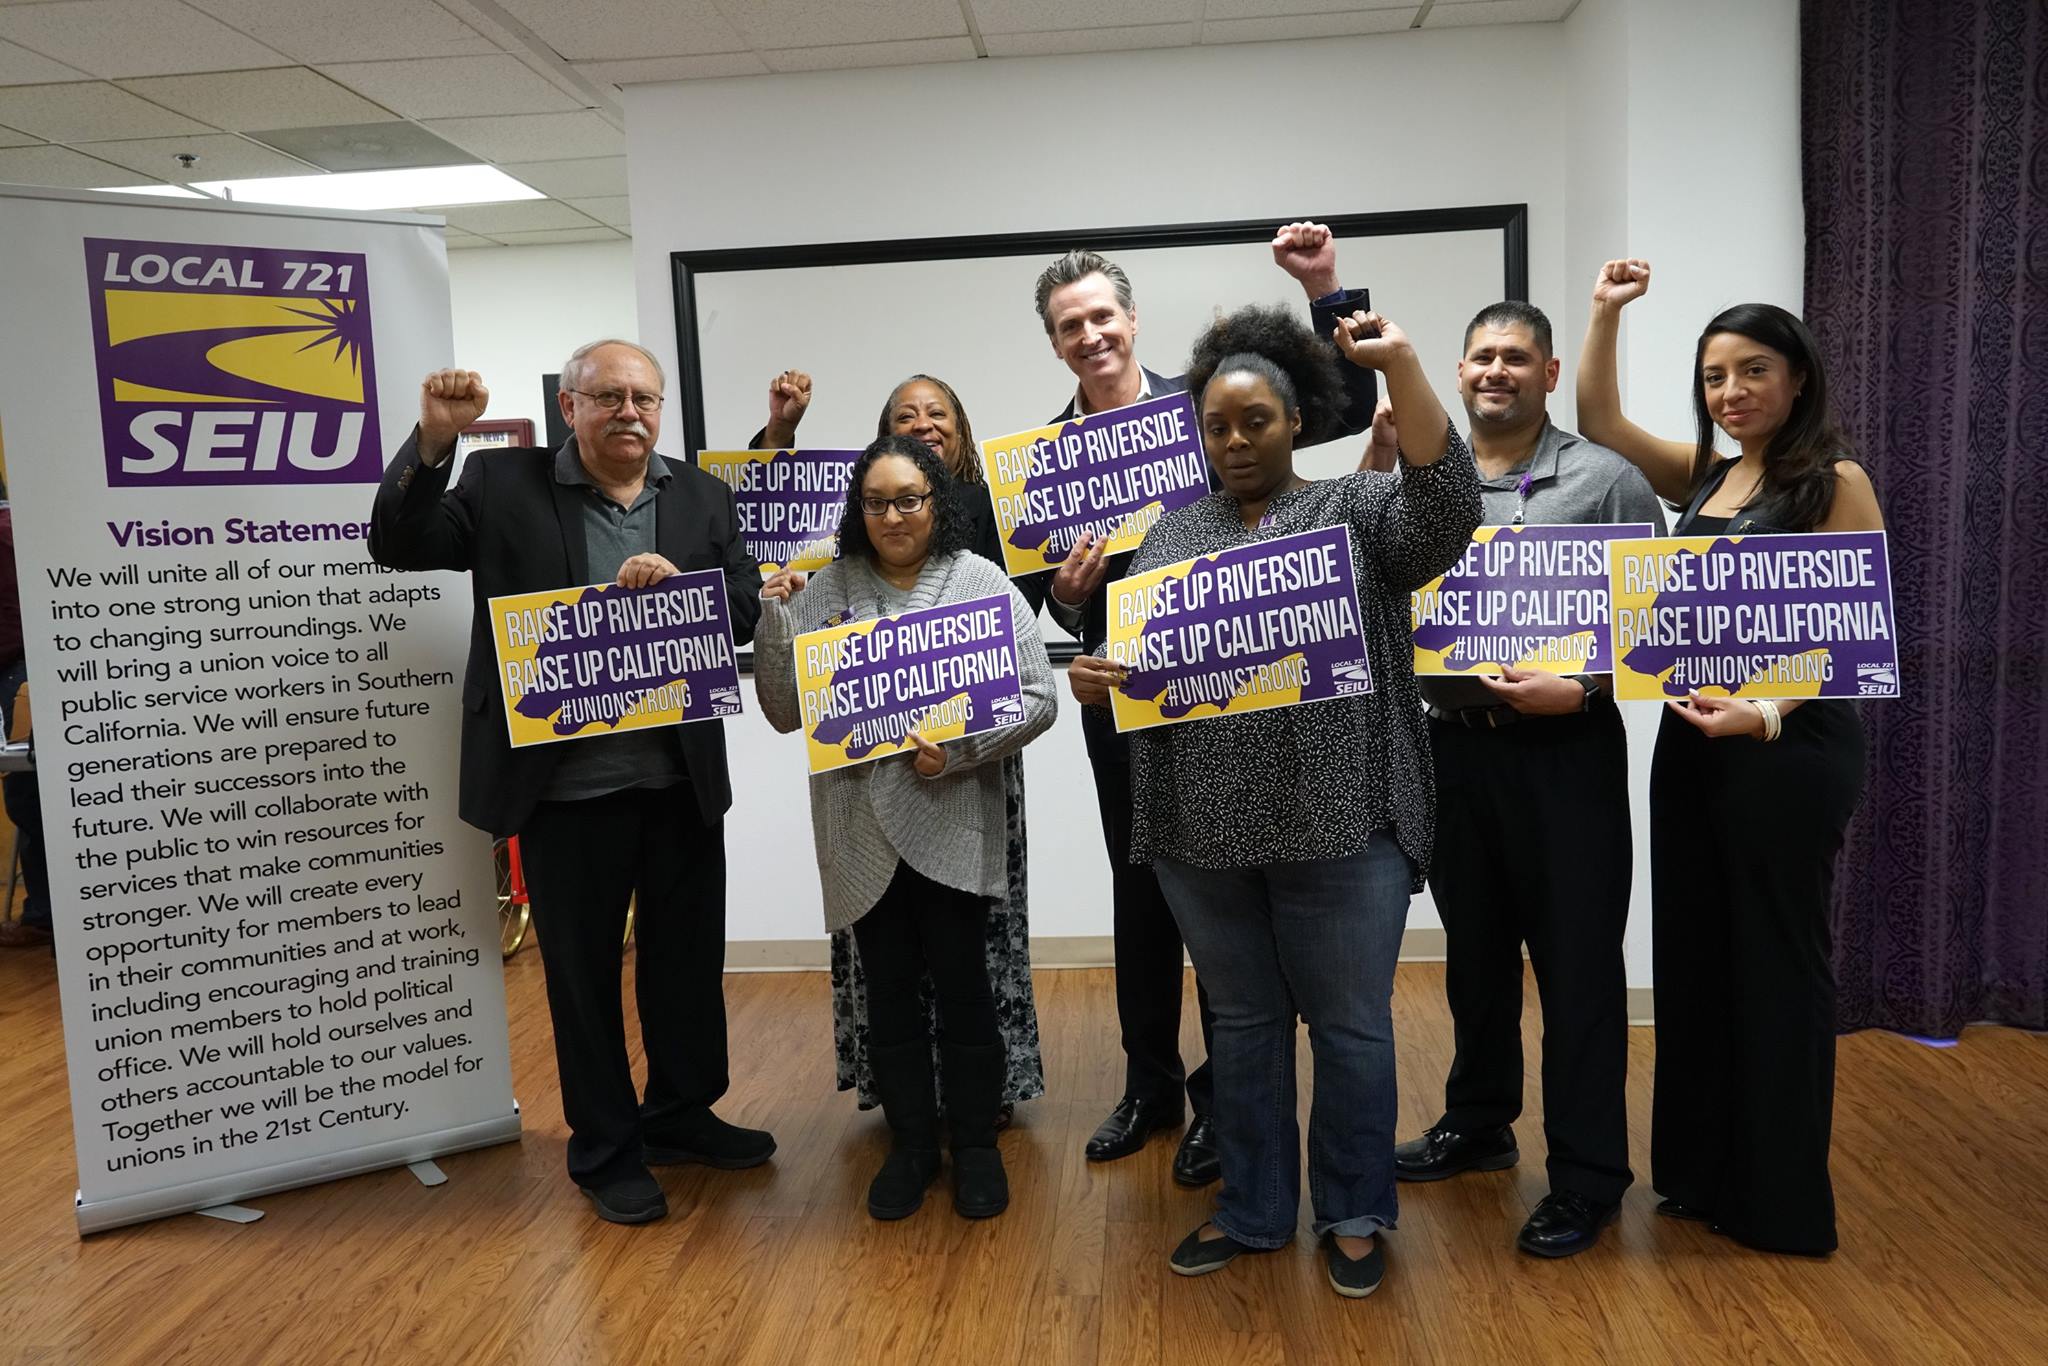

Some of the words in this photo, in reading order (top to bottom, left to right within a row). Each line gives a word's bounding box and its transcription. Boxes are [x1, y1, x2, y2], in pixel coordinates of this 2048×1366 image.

[104, 252, 264, 289] LOCAL
[282, 262, 354, 292] 721
[121, 411, 365, 474] SEIU
[994, 444, 1056, 485] RAISE
[1056, 434, 1084, 471] UP
[1084, 407, 1189, 464] RIVERSIDE
[767, 462, 791, 492] UP
[998, 488, 1058, 532] RAISE
[1058, 480, 1085, 517] UP
[1087, 451, 1205, 511] CALIFORNIA
[107, 520, 213, 547] Vision
[762, 503, 785, 533] UP
[789, 502, 847, 533] CALIFO
[47, 568, 91, 587] We
[100, 564, 138, 585] will
[148, 564, 207, 584] unite
[216, 560, 239, 581] all
[248, 559, 270, 579] of
[279, 564, 315, 578] our
[1484, 541, 1515, 577] UP
[1520, 540, 1609, 577] RIVERSI
[1623, 554, 1697, 594] RAISE
[1701, 553, 1735, 591] UP
[1740, 548, 1876, 590] RIVERSIDE
[51, 600, 100, 619] into
[109, 602, 155, 616] one
[164, 597, 240, 616] strong
[249, 590, 310, 609] union
[317, 586, 361, 606] that
[369, 583, 440, 608] adapts
[1118, 579, 1179, 628] RAISE
[1182, 570, 1213, 611] UP
[1216, 543, 1341, 604] RIVERSIDE
[1476, 590, 1507, 626] UP
[1512, 590, 1611, 626] CALIFOR
[53, 635, 81, 651] to
[90, 626, 201, 651] changing
[210, 617, 362, 642] surroundings.
[369, 613, 406, 632] We
[505, 605, 572, 648] RAISE
[574, 601, 603, 638] UP
[606, 586, 718, 633] RIVERSIDE
[806, 635, 863, 678] RAISE
[866, 629, 894, 663] UP
[898, 607, 1003, 657] RIVERSIDE
[1179, 623, 1210, 665] UP
[1214, 597, 1357, 659] CALIFORNIA
[1618, 606, 1692, 647] RAISE
[1696, 606, 1730, 645] UP
[1735, 601, 1890, 644] CALIFORNIA
[505, 654, 573, 697] RAISE
[574, 650, 604, 687] UP
[607, 633, 732, 683] CALIFORNIA
[1331, 660, 1353, 669] LOCAL
[1454, 635, 1598, 662] #UNIONSTRONG
[1674, 654, 1833, 685] #UNIONSTRONG
[62, 690, 137, 721] public
[145, 685, 227, 707] service
[235, 678, 325, 700] workers
[332, 675, 350, 693] in
[358, 668, 453, 691] Southern
[561, 683, 692, 726] #UNIONSTRONG
[804, 679, 862, 726] RAISE
[864, 672, 891, 710] UP
[895, 646, 1014, 701] CALIFORNIA
[1166, 658, 1311, 707] #UNIONSTRONG
[1336, 680, 1369, 695] SEIU
[1858, 684, 1895, 695] SEIU
[64, 718, 186, 745] California.
[193, 714, 234, 733] We
[242, 708, 277, 729] will
[286, 708, 359, 726] ensure
[365, 700, 429, 719] future
[712, 704, 740, 716] SEIU
[852, 696, 974, 748] #UNIONSTRONG
[994, 712, 1022, 726] SEIU
[68, 749, 212, 782] generations
[221, 747, 257, 762] are
[265, 729, 367, 764] prepared
[373, 732, 396, 747] to
[71, 782, 123, 807] lead
[131, 779, 186, 801] their
[195, 770, 316, 794] successors
[323, 764, 364, 781] into
[370, 757, 406, 776] the
[72, 817, 153, 838] future.
[161, 807, 202, 828] We
[210, 800, 246, 823] will
[255, 792, 377, 818] collaborate
[384, 782, 428, 803] with
[75, 848, 117, 869] the
[126, 838, 198, 870] public
[204, 838, 229, 853] to
[237, 830, 276, 849] win
[285, 820, 389, 844] resources
[395, 811, 424, 830] for
[80, 875, 177, 900] services
[184, 866, 232, 886] that
[240, 856, 300, 879] make
[309, 840, 444, 870] communities
[83, 904, 191, 930] stronger.
[198, 893, 239, 914] We
[246, 885, 281, 908] will
[290, 880, 358, 902] create
[365, 873, 423, 891] every
[86, 926, 230, 966] opportunity
[237, 919, 269, 939] for
[278, 906, 382, 933] members
[387, 902, 410, 916] to
[418, 889, 461, 912] lead
[89, 973, 109, 991] in
[117, 963, 173, 986] their
[181, 942, 326, 976] communities
[334, 930, 373, 954] and
[382, 930, 402, 946] at
[408, 918, 465, 942] work,
[92, 992, 200, 1022] including
[209, 968, 349, 1002] encouraging
[356, 955, 395, 979] and
[401, 947, 479, 971] training
[96, 1028, 162, 1052] union
[171, 1009, 281, 1039] members
[288, 1004, 312, 1019] to
[319, 988, 366, 1014] hold
[375, 974, 452, 1011] political
[98, 1057, 172, 1081] office.
[179, 1045, 220, 1066] We
[228, 1035, 263, 1058] will
[272, 1025, 320, 1051] hold
[329, 1012, 427, 1041] ourselves
[435, 999, 472, 1022] and
[101, 1087, 178, 1111] others
[187, 1056, 324, 1096] accountable
[330, 1054, 353, 1069] to
[361, 1046, 396, 1063] our
[403, 1033, 472, 1055] values.
[107, 1145, 185, 1172] unions
[193, 1137, 213, 1154] in
[220, 1128, 258, 1148] the
[266, 1117, 311, 1140] 21st
[319, 1101, 408, 1128] Century.
